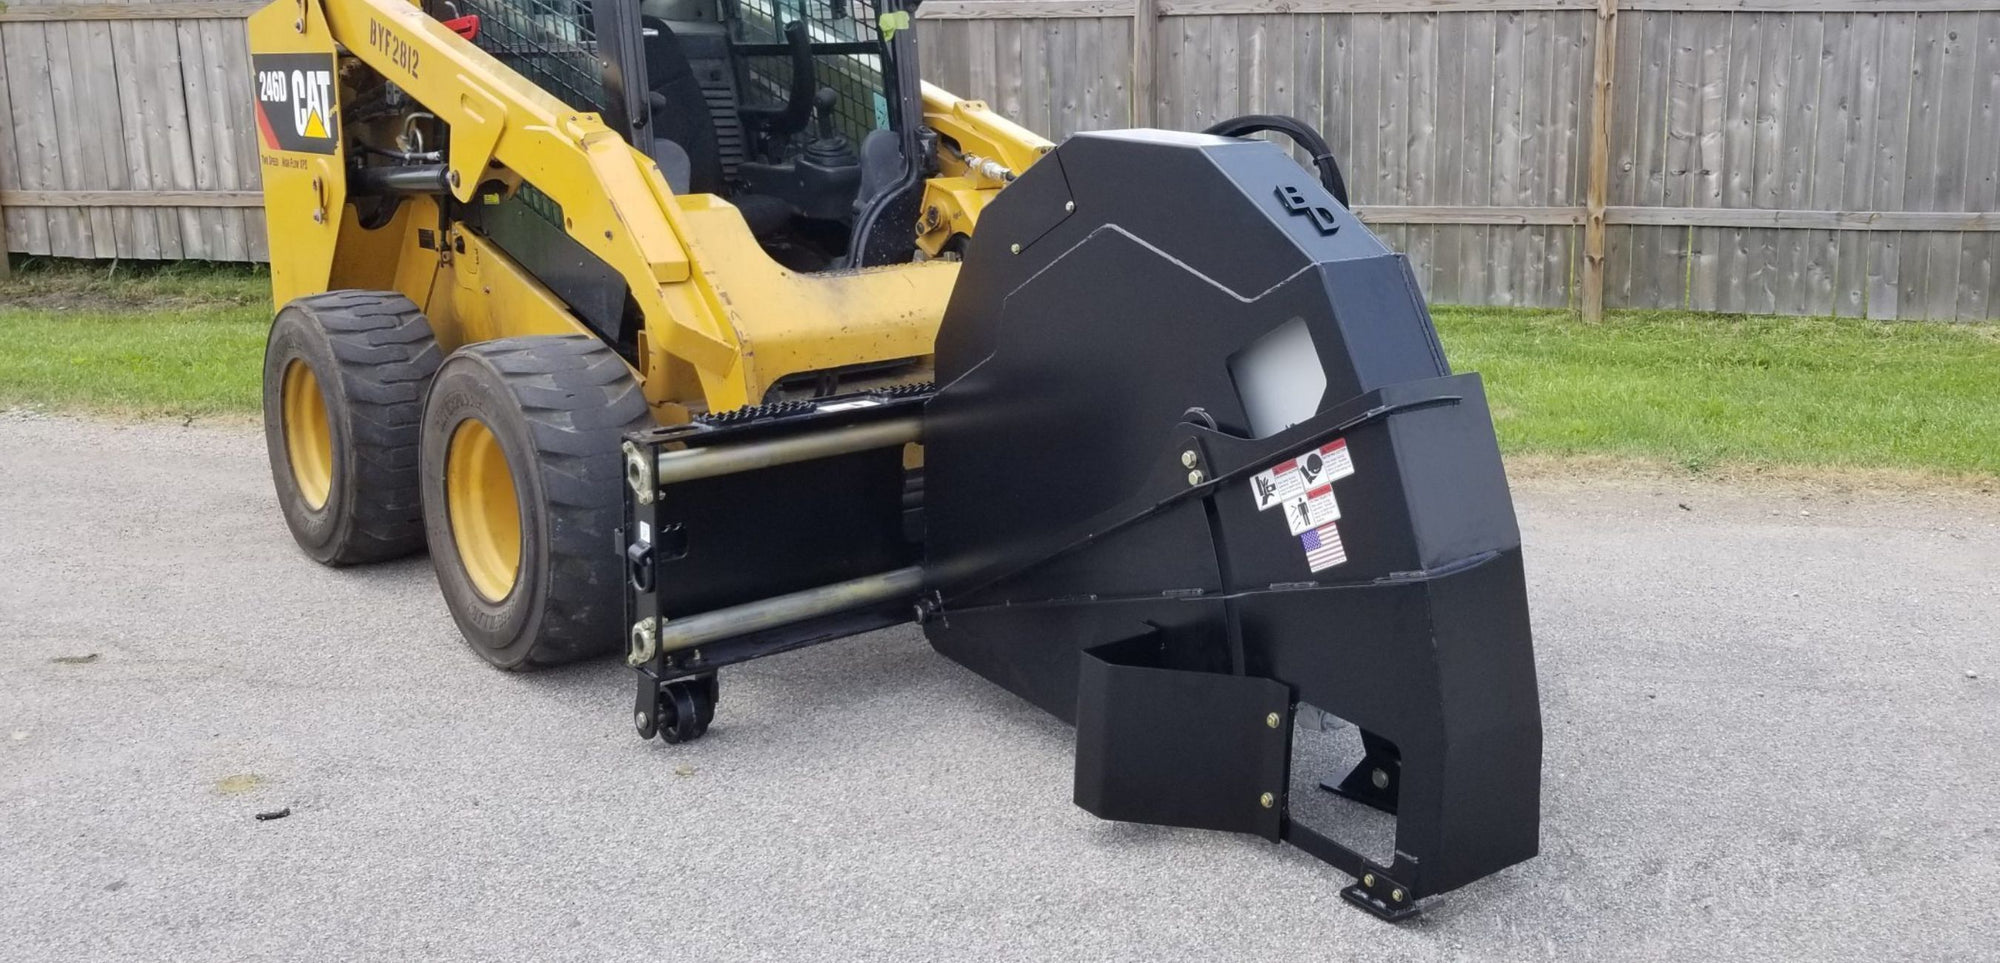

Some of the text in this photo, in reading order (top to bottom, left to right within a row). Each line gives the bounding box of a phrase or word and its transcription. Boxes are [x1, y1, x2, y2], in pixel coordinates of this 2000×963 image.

[369, 17, 420, 79] BYF2812
[259, 71, 287, 102] 246D
[291, 69, 332, 139] CAT
